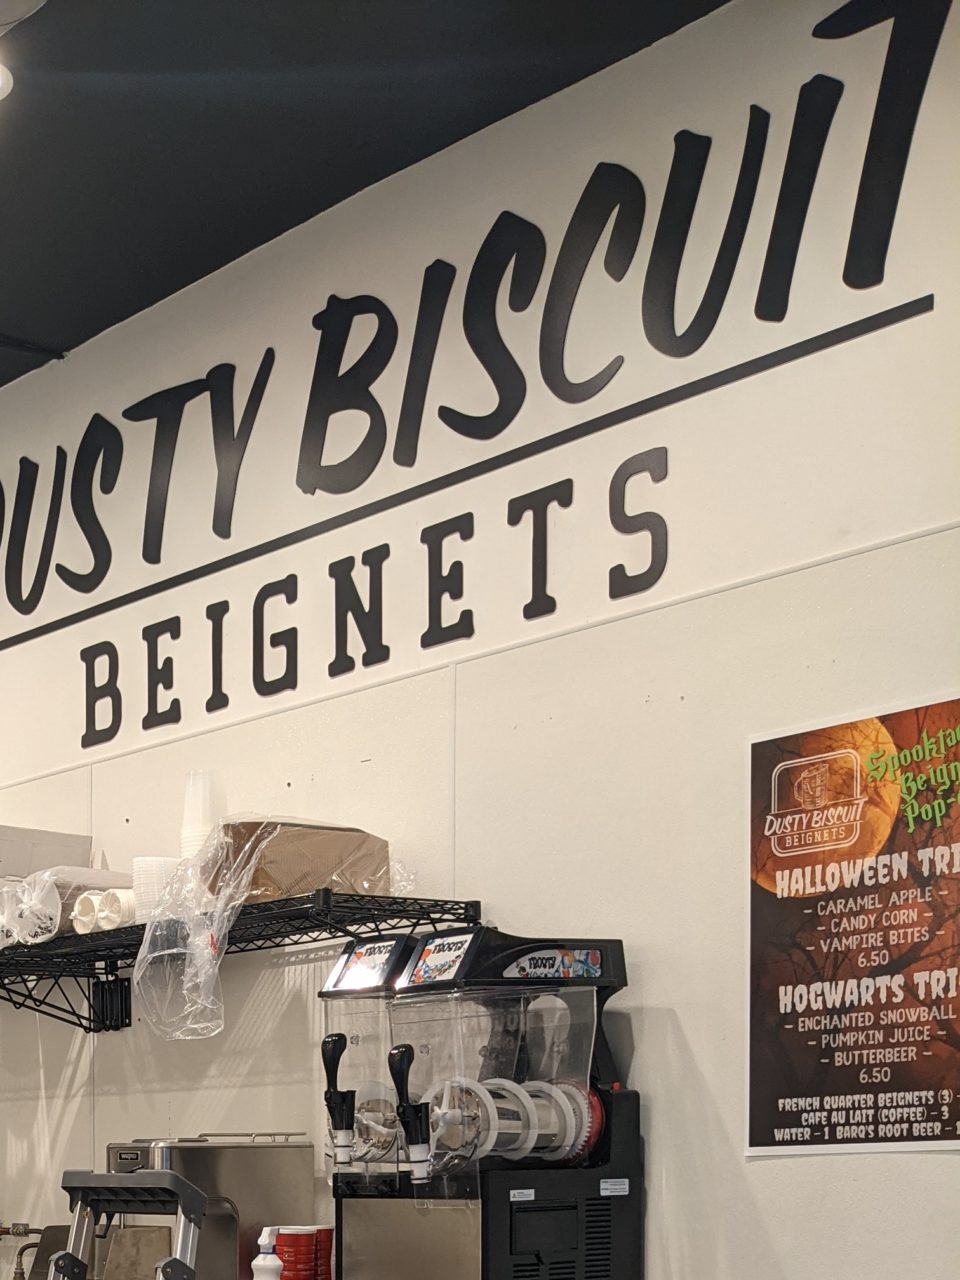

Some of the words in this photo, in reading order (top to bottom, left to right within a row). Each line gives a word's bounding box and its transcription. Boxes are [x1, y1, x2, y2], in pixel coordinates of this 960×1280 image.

[297, 0, 957, 494] BISCUIT
[79, 445, 668, 748] BEIGNETS
[764, 810, 814, 836] DUSTY
[811, 800, 864, 828] BISCUIT
[785, 826, 846, 847] BEIGNETS
[775, 851, 909, 898] HALLOWEEN
[817, 894, 883, 916] CARAMEL
[888, 886, 933, 907] APPLE
[830, 914, 878, 933] CANDY
[882, 908, 918, 926] CORN
[820, 931, 884, 953] VAMPIRE
[889, 927, 930, 946] BITES
[857, 949, 889, 968] 6.50
[778, 974, 905, 1014] HOGWARTS
[913, 967, 960, 1001] TRI
[798, 1012, 874, 1032] ENCHANTED
[879, 1004, 957, 1026] SNOWBALL
[821, 1030, 884, 1048] PUMPKIN
[889, 1026, 931, 1044] JUICE
[834, 1047, 917, 1066] BUTTERBEER
[859, 1067, 891, 1084] 6.50
[778, 1096, 821, 1112] FRENCH
[823, 1093, 874, 1110] QUARTER
[877, 1090, 935, 1107] BEIGNETS
[938, 1089, 954, 1104] (3)
[801, 1111, 828, 1126] CAFE
[831, 1110, 846, 1124] AU
[849, 1109, 875, 1124] LAIT
[877, 1107, 928, 1123] (COFFEE)
[941, 1106, 950, 1120] 3
[773, 1127, 811, 1141] WATER
[823, 1127, 830, 1140] 1
[836, 1125, 875, 1140] BARQ'S
[878, 1122, 909, 1138] ROOT
[912, 1121, 941, 1136] BEER
